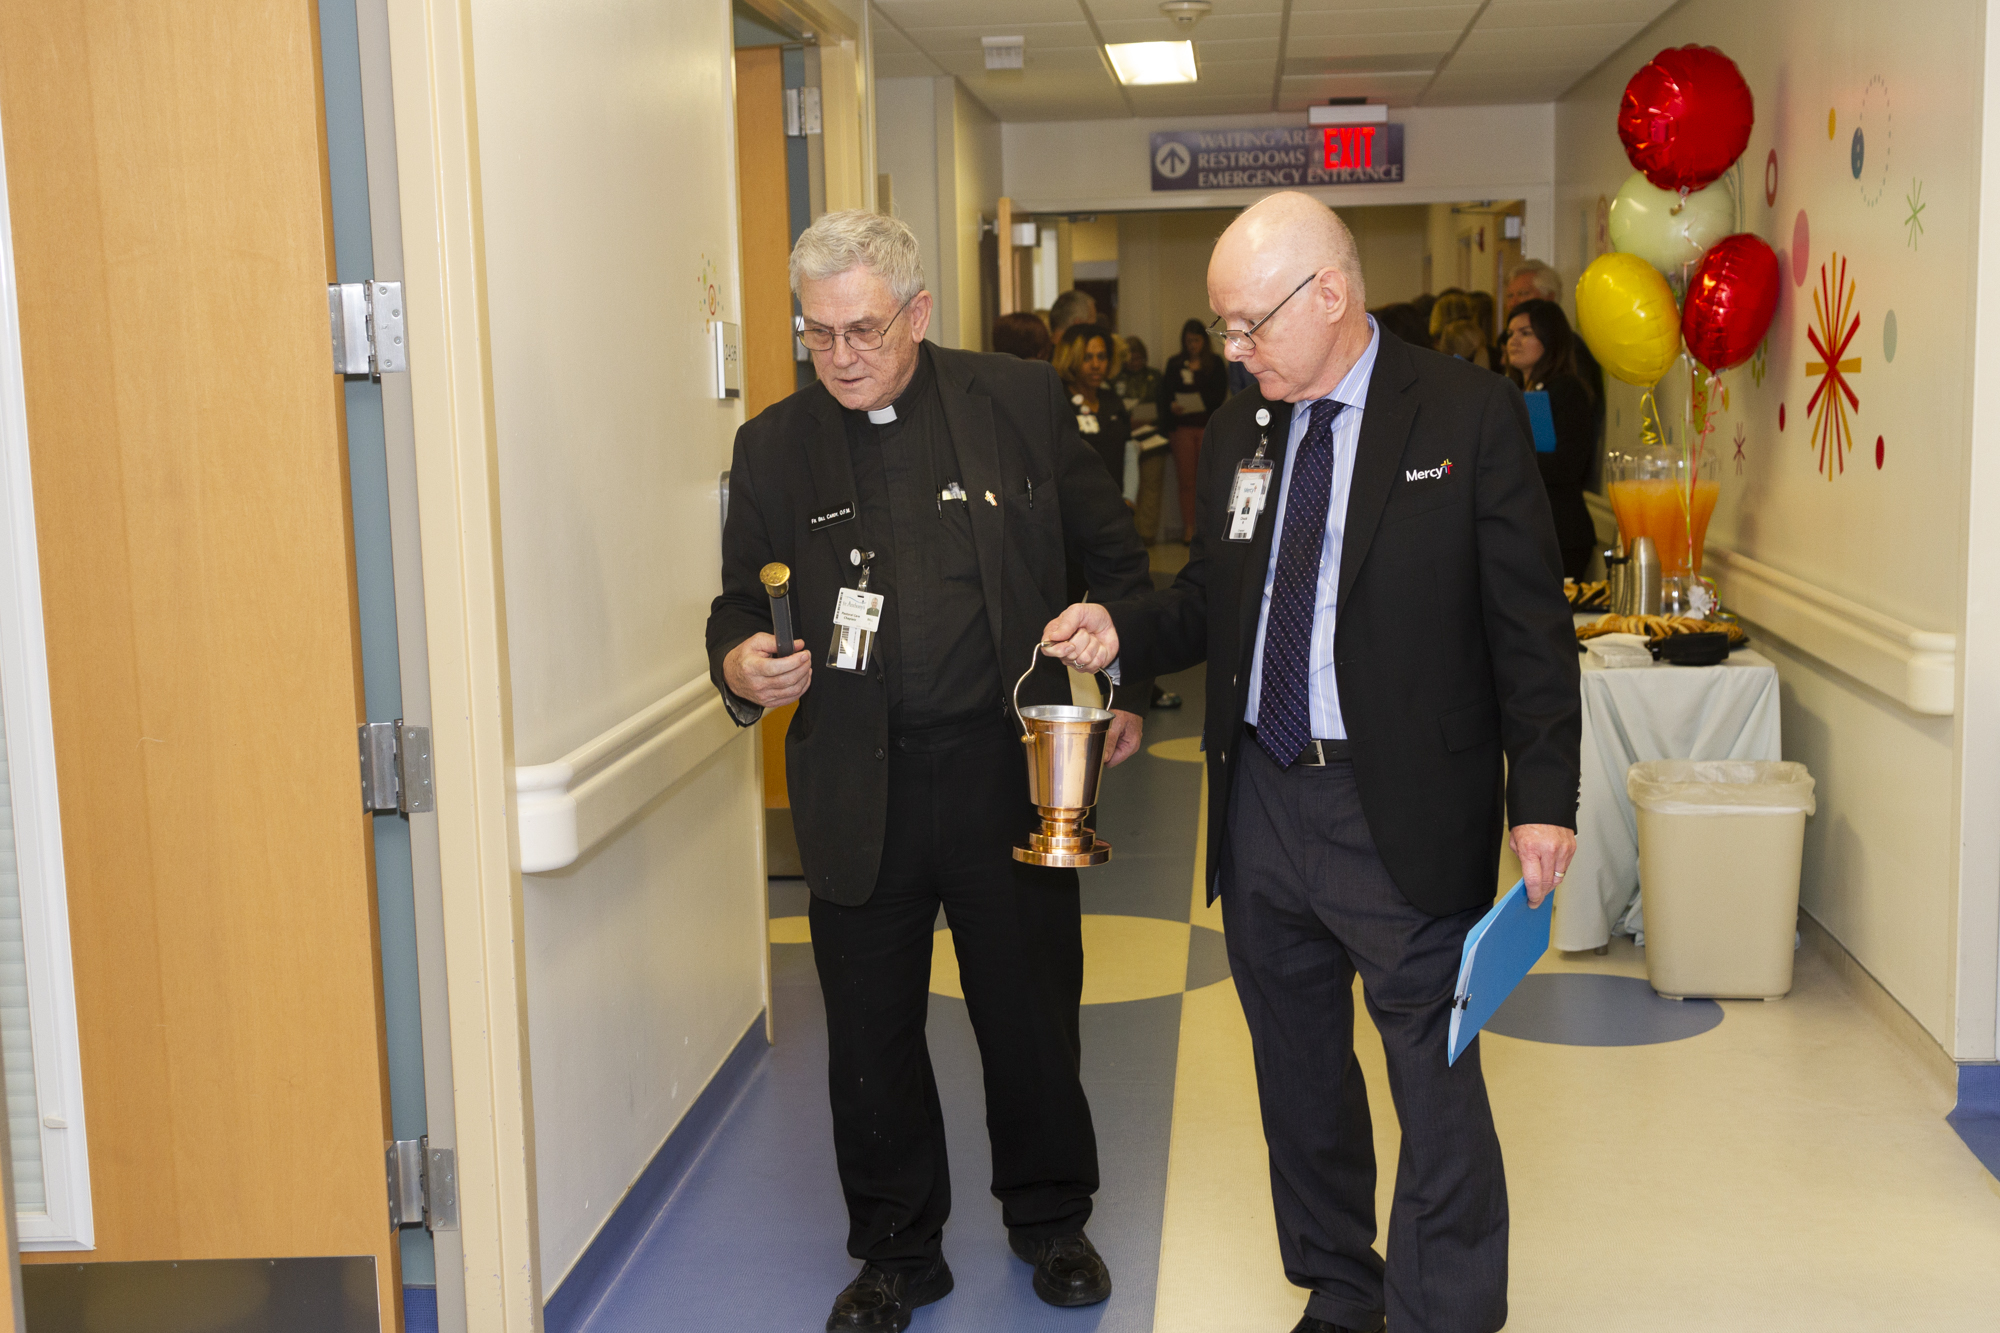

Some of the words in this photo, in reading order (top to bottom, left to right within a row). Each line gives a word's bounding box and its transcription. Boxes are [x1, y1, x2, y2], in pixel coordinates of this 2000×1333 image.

[1199, 129, 1276, 150] WAITING
[1324, 127, 1376, 169] EXIT
[1198, 148, 1306, 169] RESTROOMS
[1198, 167, 1303, 188] EMERGENCY
[1306, 163, 1401, 184] ENTRANCE
[1405, 466, 1444, 482] Mercy
